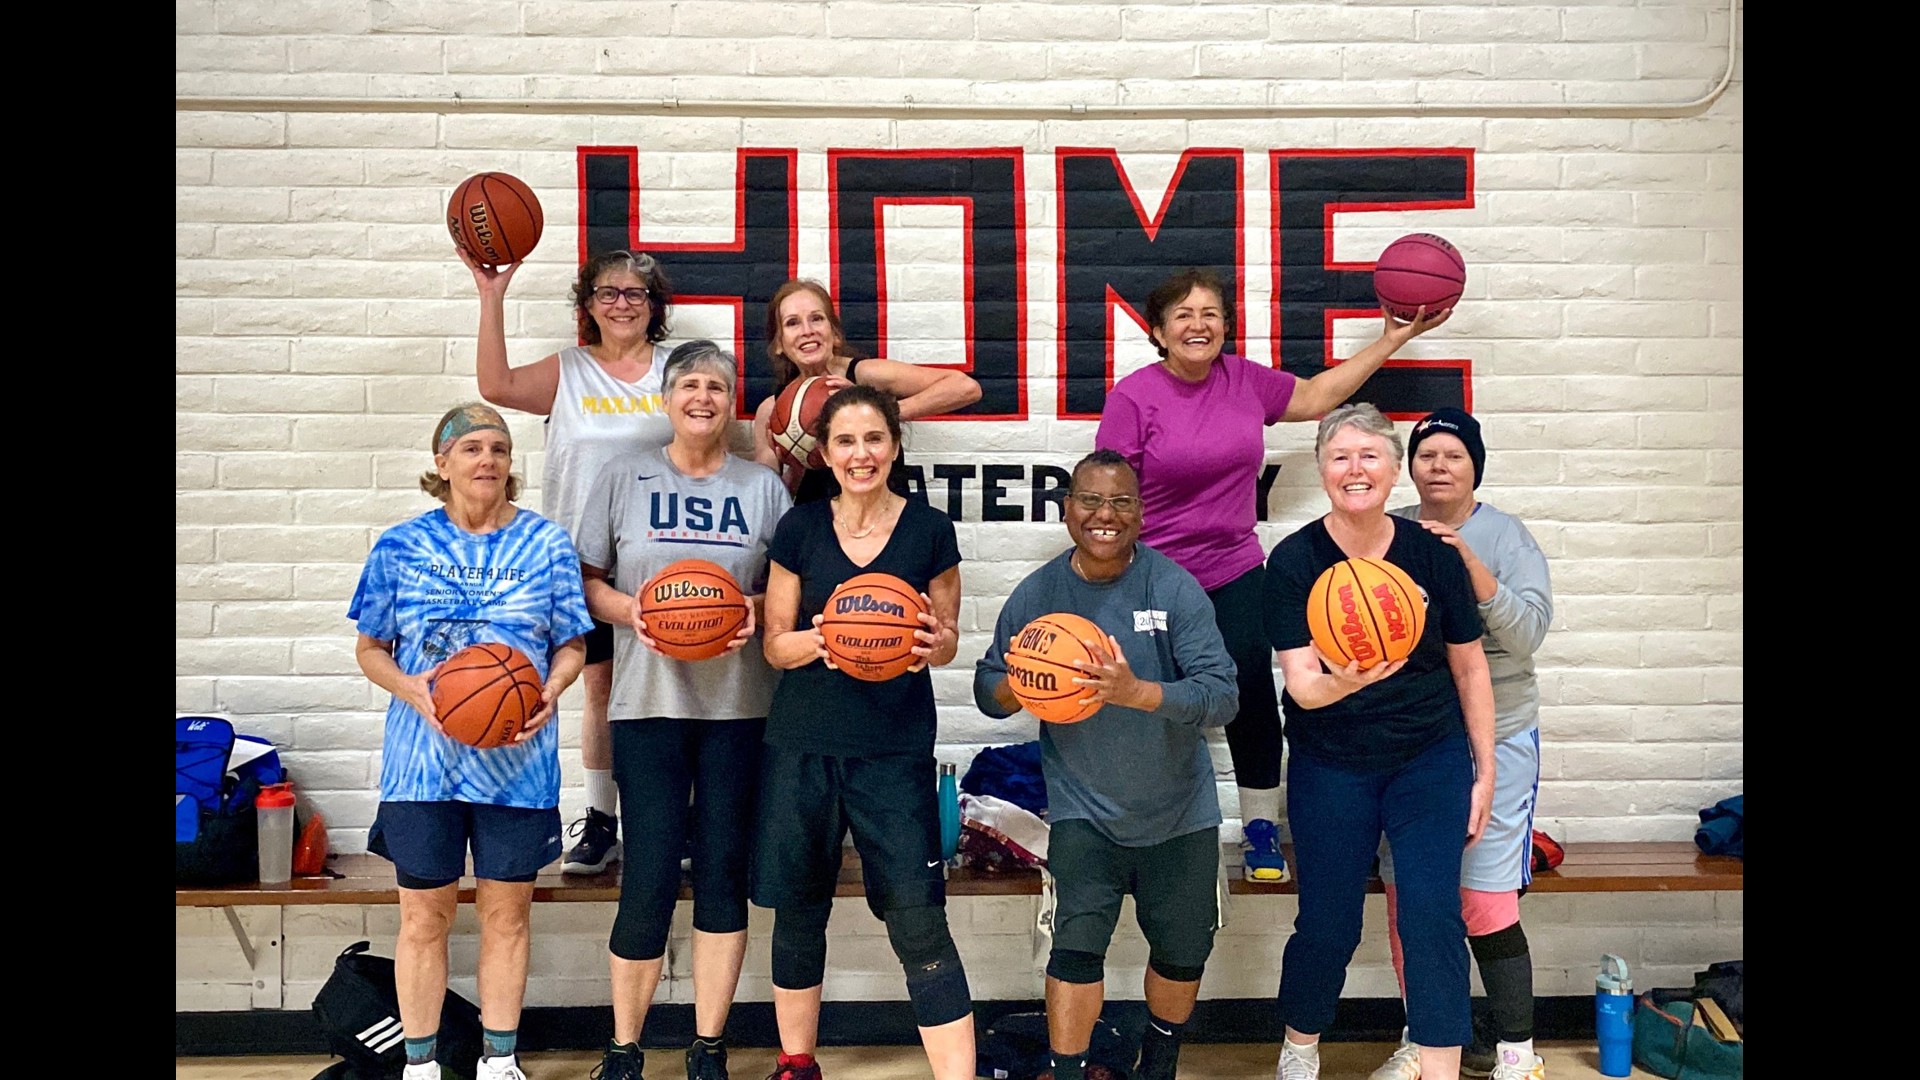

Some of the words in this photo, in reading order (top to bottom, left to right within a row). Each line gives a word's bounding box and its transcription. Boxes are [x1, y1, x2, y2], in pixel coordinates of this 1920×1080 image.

[469, 202, 500, 261] Wilson
[576, 146, 1475, 421] HOME
[650, 491, 750, 535] USA
[647, 530, 752, 543] BASKETBALL
[420, 598, 477, 606] BASKETBALL
[479, 599, 507, 607] CAMP
[425, 588, 459, 597] SENIOR
[461, 590, 504, 598] WOMEN'S
[655, 581, 724, 603] Wilson
[836, 594, 904, 618] Wilson
[1371, 583, 1407, 641] NCAA
[658, 617, 724, 631] EVOLUTION
[1338, 583, 1376, 661] Wilson
[836, 634, 903, 648] EVOLUTION
[1007, 664, 1058, 691] Wilso
